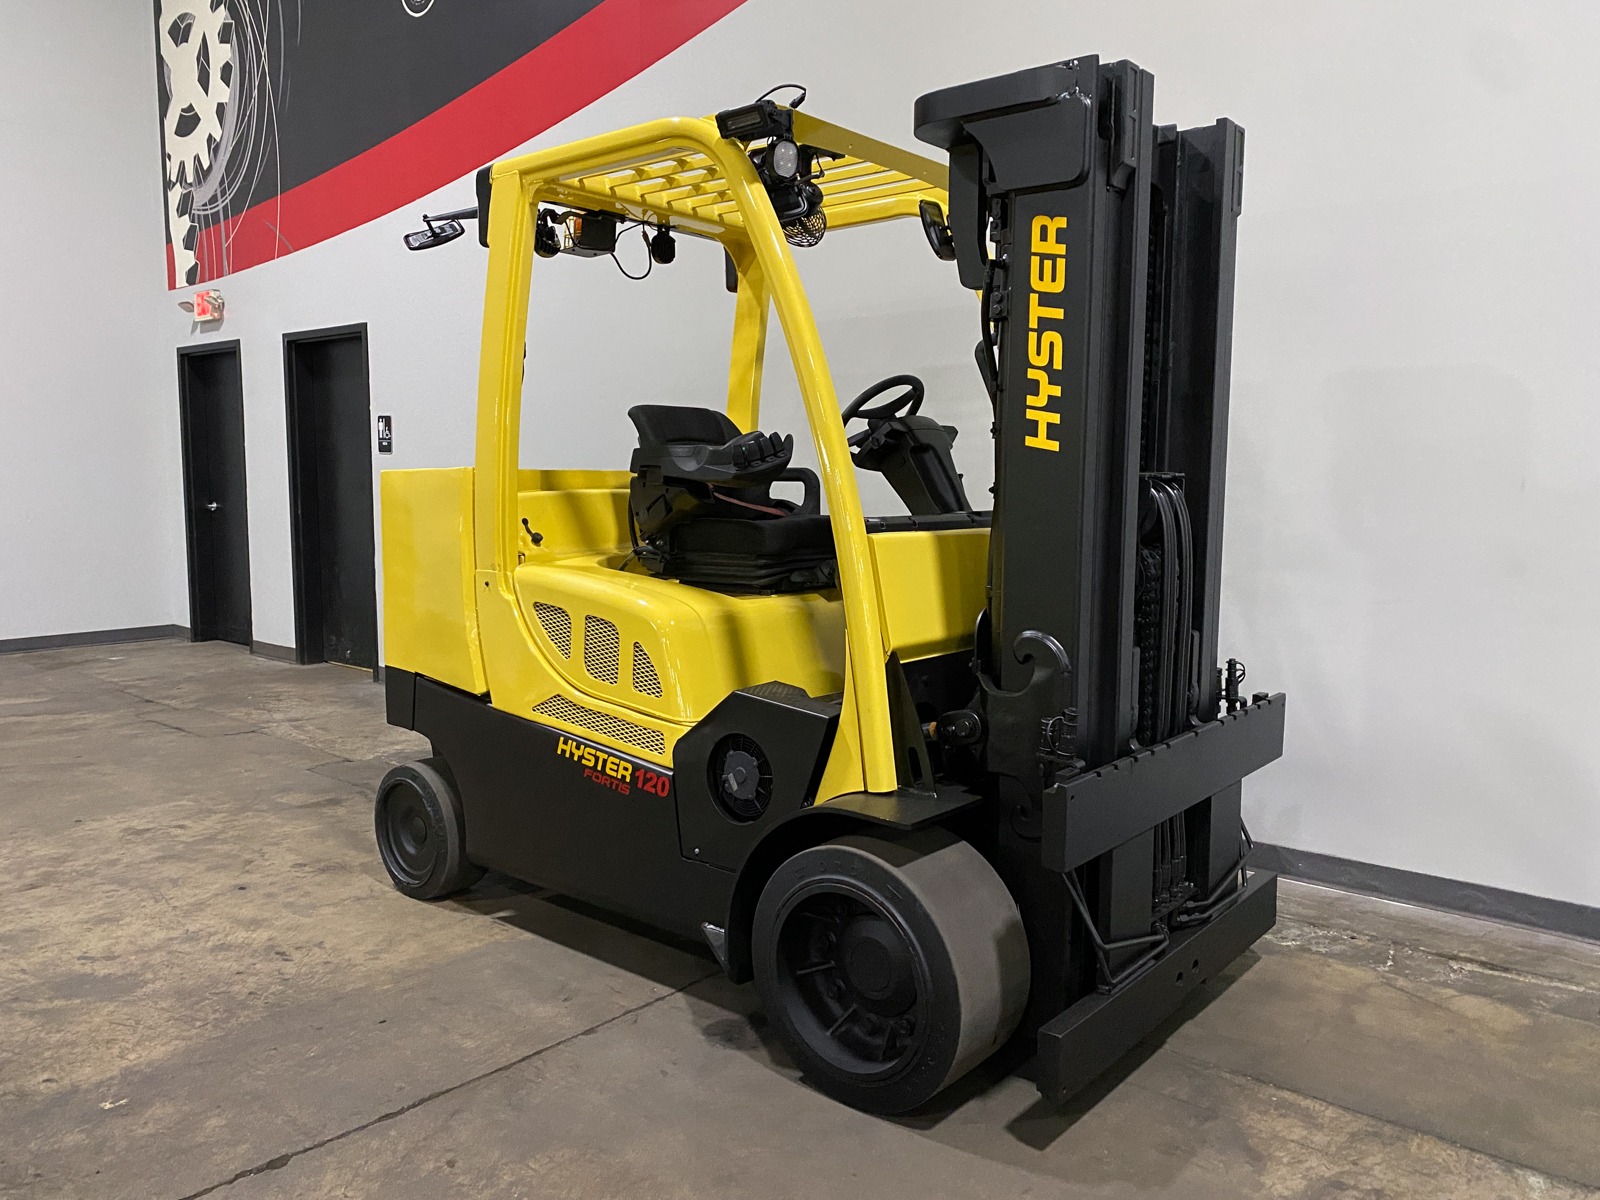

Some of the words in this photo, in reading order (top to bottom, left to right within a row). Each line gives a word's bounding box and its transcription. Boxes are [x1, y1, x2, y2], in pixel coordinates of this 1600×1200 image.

[1025, 214, 1067, 452] HYSTER
[557, 736, 633, 782] HYSTER
[635, 768, 670, 797] 120
[583, 769, 631, 795] FORTIS
